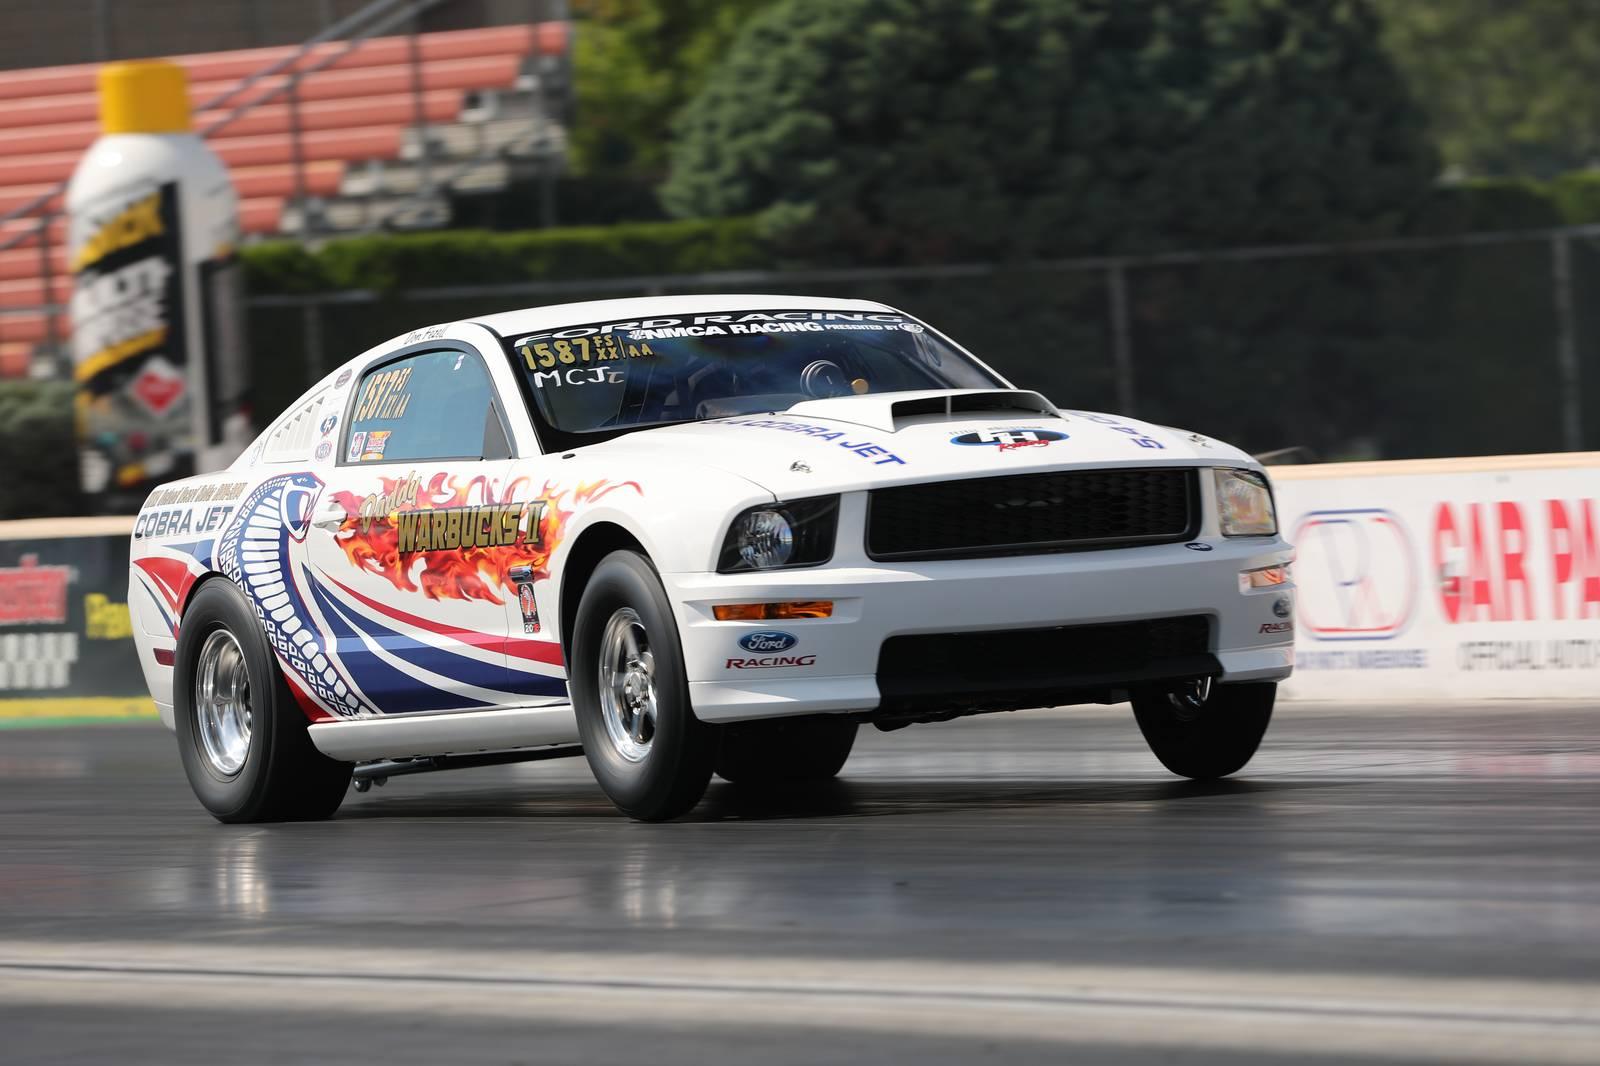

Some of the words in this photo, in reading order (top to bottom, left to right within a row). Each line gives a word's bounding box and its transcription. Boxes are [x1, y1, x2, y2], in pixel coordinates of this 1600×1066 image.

[645, 325, 727, 340] NMCA
[732, 322, 825, 334] RACING
[693, 312, 904, 325] RACING
[521, 338, 590, 370] 1587
[839, 442, 906, 465] JET
[359, 470, 422, 535] Daddy
[135, 508, 193, 538] COBRA
[196, 506, 234, 532] JET
[397, 502, 523, 554] WARBUCKS
[1434, 500, 1536, 624] CAR
[748, 633, 787, 649] Ford
[725, 655, 817, 669] RACING
